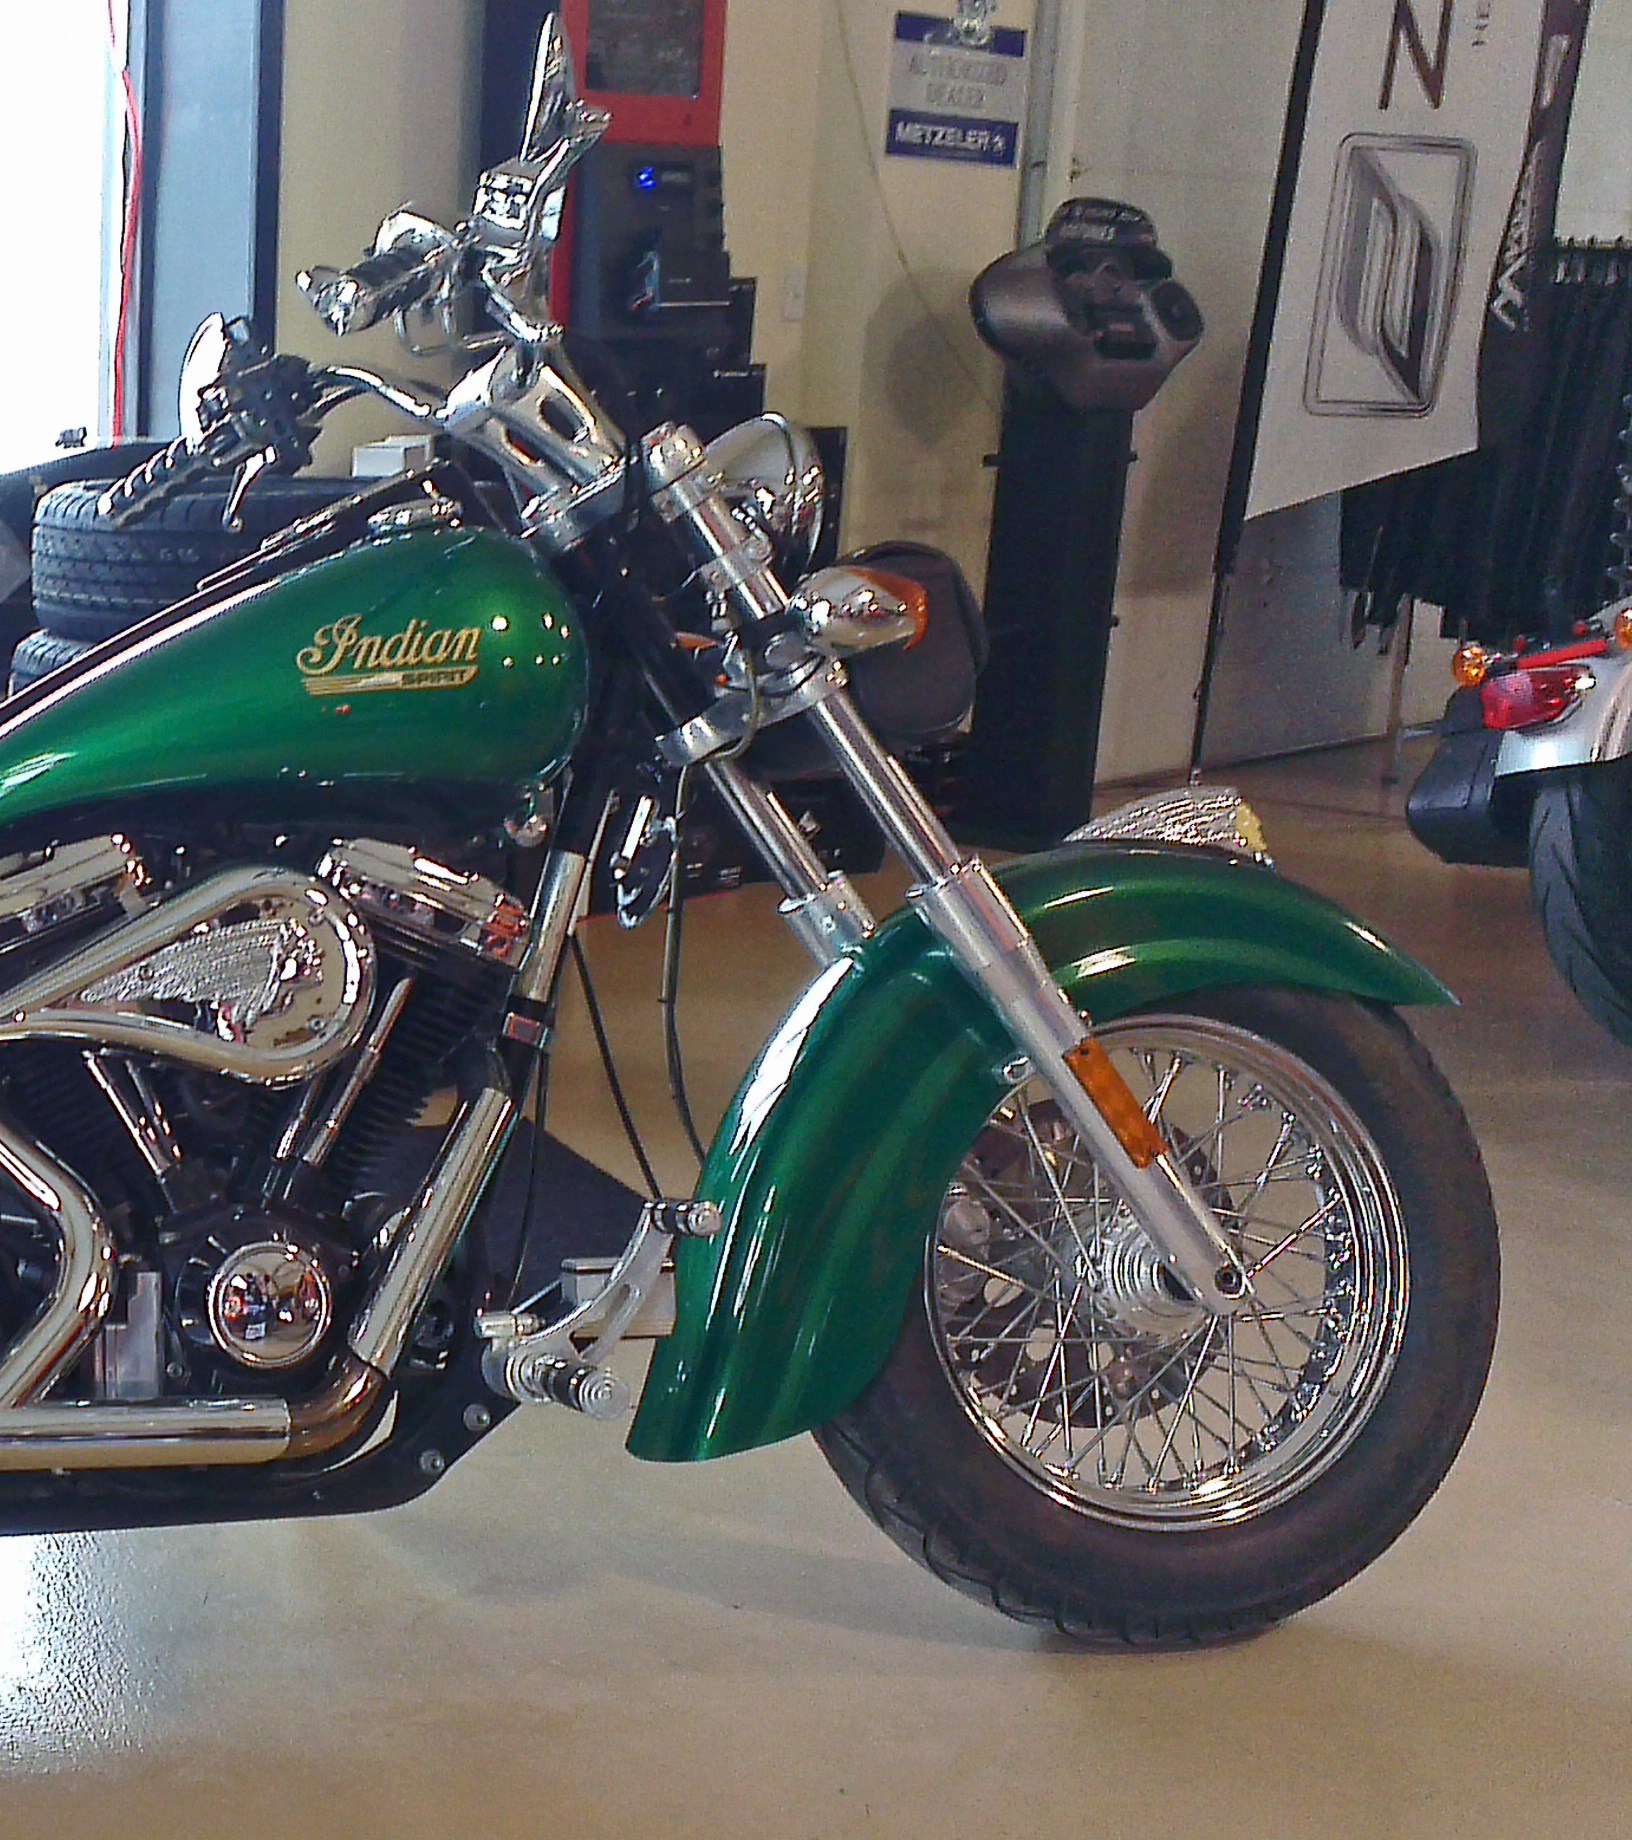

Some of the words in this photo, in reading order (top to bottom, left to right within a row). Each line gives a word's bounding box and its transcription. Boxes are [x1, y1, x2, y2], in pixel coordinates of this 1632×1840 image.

[894, 121, 990, 152] METZELER
[296, 613, 483, 677] Indian
[401, 670, 468, 687] SPIRIT
